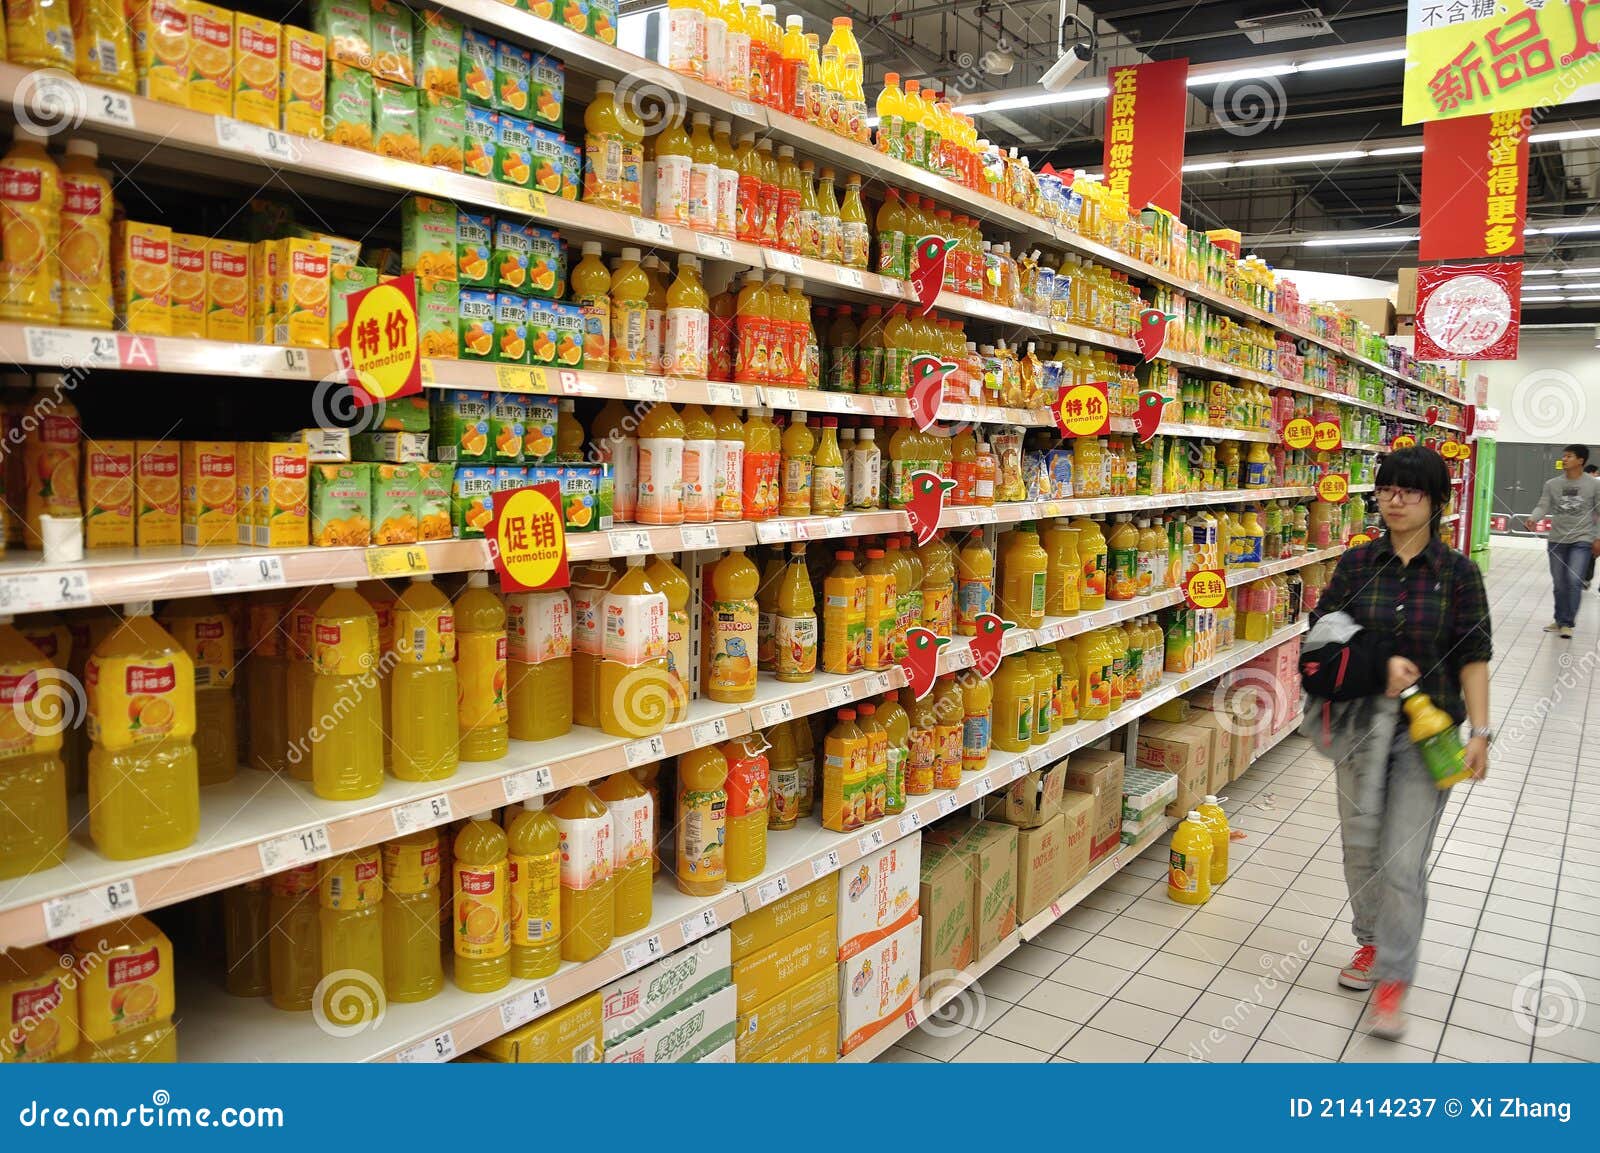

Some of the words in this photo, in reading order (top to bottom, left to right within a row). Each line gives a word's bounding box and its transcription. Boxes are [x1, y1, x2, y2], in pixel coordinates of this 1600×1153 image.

[357, 309, 408, 359] 特价
[359, 350, 412, 372] promotion
[1065, 396, 1102, 416] 特价
[1066, 415, 1104, 424] promotion
[505, 512, 556, 552] 促销
[506, 550, 558, 566] promotion
[1193, 580, 1222, 594] 促销
